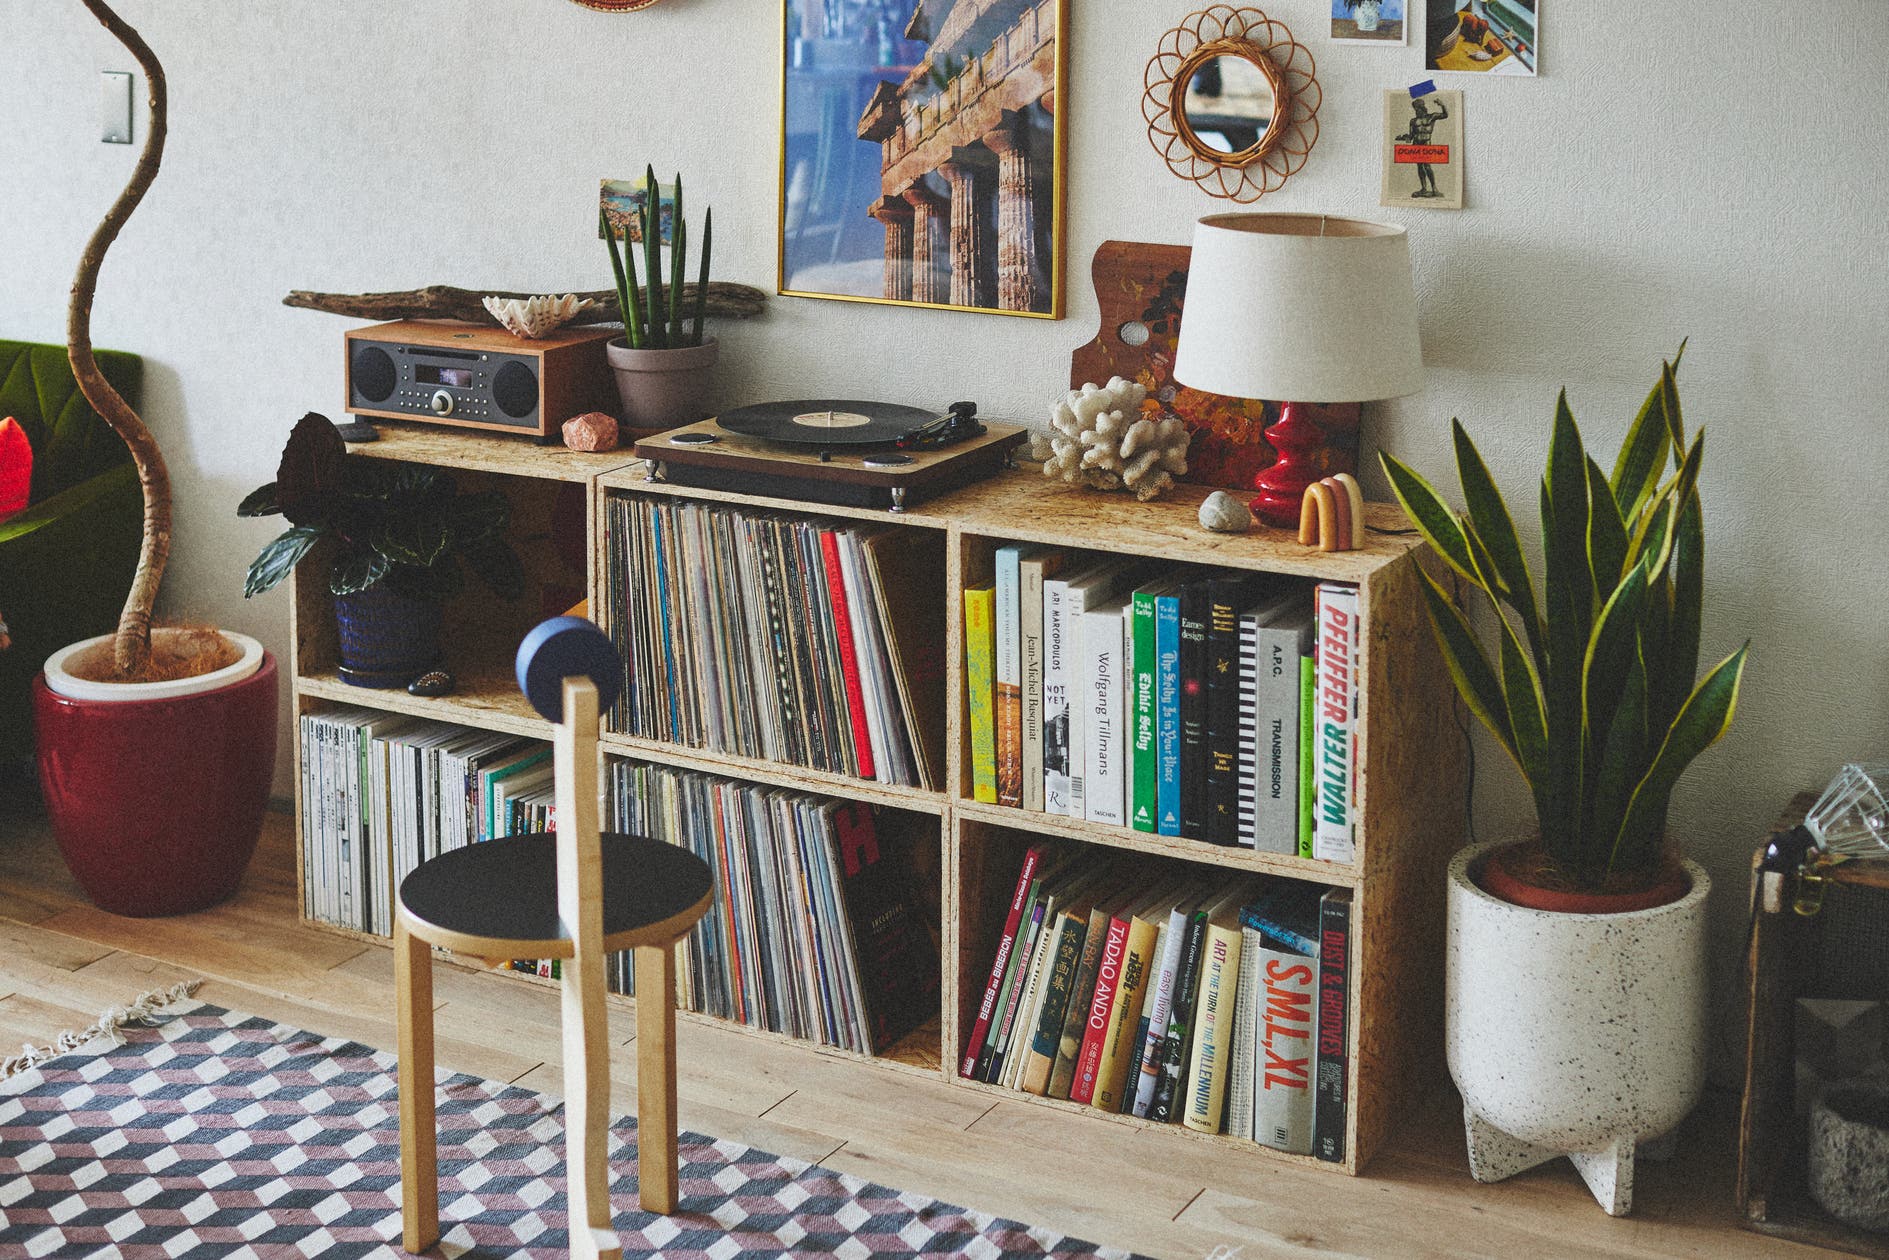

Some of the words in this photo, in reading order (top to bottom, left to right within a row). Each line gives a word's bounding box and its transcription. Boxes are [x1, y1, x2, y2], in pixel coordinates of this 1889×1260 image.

[1052, 591, 1060, 605] ARI
[1135, 600, 1152, 610] Todd
[1159, 604, 1176, 613] Todd
[1135, 608, 1153, 618] Selby
[1181, 617, 1205, 630] Eames
[1052, 610, 1061, 671] MARCOPOULOS
[1181, 629, 1205, 643] design
[1026, 634, 1039, 696] Jean-Michel
[1161, 650, 1178, 672] The
[1273, 644, 1283, 678] A.P.C.
[1323, 603, 1349, 723] PFEIFFER
[1046, 684, 1066, 695] NOT
[1095, 652, 1111, 715] Wolfgang
[1138, 672, 1152, 713] Edible
[1161, 672, 1176, 704] Selby
[1047, 696, 1066, 705] YET
[1162, 706, 1177, 718] Is
[1026, 698, 1040, 741] Basquiat
[1164, 719, 1175, 730] in
[1136, 715, 1152, 751] Selby
[1160, 730, 1177, 755] Your
[1098, 718, 1111, 776] Tillmans
[1271, 718, 1282, 799] TRANSMISSION
[1162, 756, 1177, 784] Place
[1322, 722, 1348, 826] WALTER
[1094, 809, 1117, 819] TASCHEN
[1191, 924, 1202, 945] Indoor
[1247, 916, 1275, 936] Powers
[992, 934, 1013, 979] BIBERON
[1036, 932, 1050, 967] Philippe
[1083, 945, 1097, 970] RAY
[1101, 926, 1125, 980] TADAO
[1187, 945, 1197, 963] Green
[1213, 938, 1227, 964] ART
[1323, 929, 1345, 971] DUST
[1211, 962, 1221, 973] AT
[1322, 973, 1343, 986] &
[1159, 970, 1172, 995] easy
[1209, 973, 1220, 990] THE
[1090, 980, 1112, 1029] ANDO
[1152, 996, 1171, 1025] living
[1206, 990, 1218, 1014] TURN
[1203, 1026, 1214, 1043] THE
[1260, 959, 1313, 1091] S,M,L,XL
[1320, 988, 1343, 1057] GROOVES
[1194, 1042, 1216, 1116] MILLENNIUM
[1189, 1116, 1212, 1127] TASCHEN
